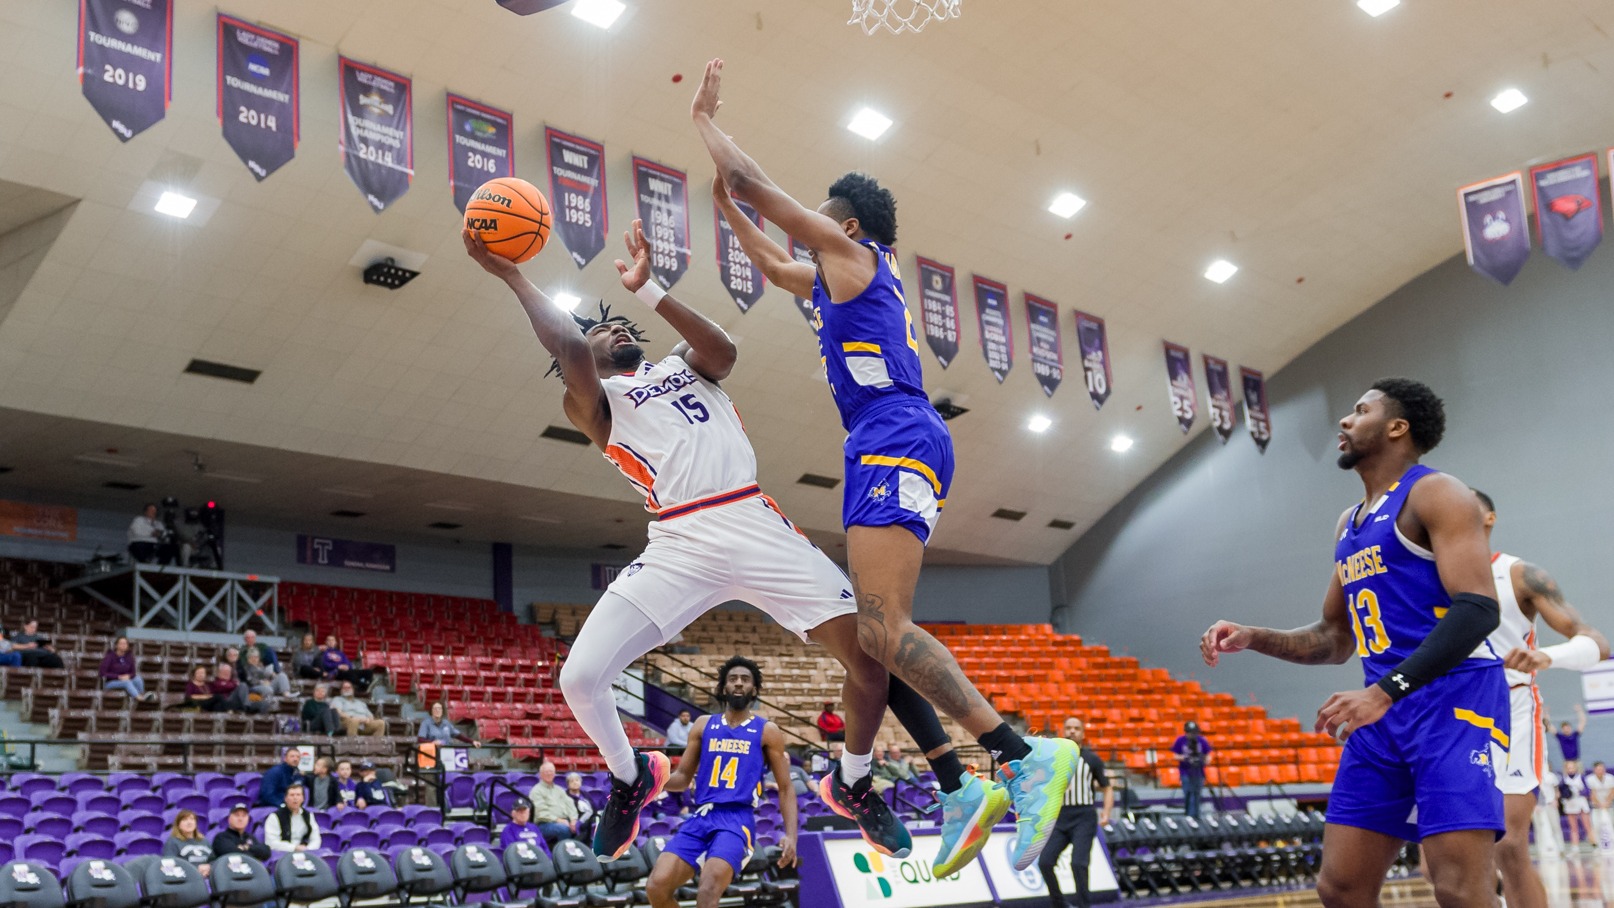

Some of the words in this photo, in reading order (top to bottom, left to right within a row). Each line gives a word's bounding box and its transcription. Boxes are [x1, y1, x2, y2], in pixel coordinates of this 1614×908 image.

[88, 31, 162, 63] TOURNAMENT
[103, 64, 147, 91] 2019
[225, 75, 290, 103] TOURNAMENT
[239, 106, 277, 132] 2014
[348, 114, 404, 140] TOURNAMENT
[359, 144, 392, 166] 2014
[455, 134, 507, 158] TOURNAMENT
[467, 152, 496, 173] 2016
[562, 149, 589, 169] WNIT
[552, 166, 599, 187] TOURNAMENT
[564, 192, 591, 212] 1986
[467, 217, 498, 231] NCAA
[565, 207, 592, 227] 1995
[653, 253, 678, 271] 1999
[729, 262, 752, 280] 2014
[730, 275, 753, 294] 2015
[670, 393, 710, 425] 15
[1335, 544, 1388, 587] McNEESE
[1348, 588, 1392, 658] 13
[708, 738, 752, 755] McNEESE
[708, 755, 739, 789] 14
[900, 860, 960, 885] QU
